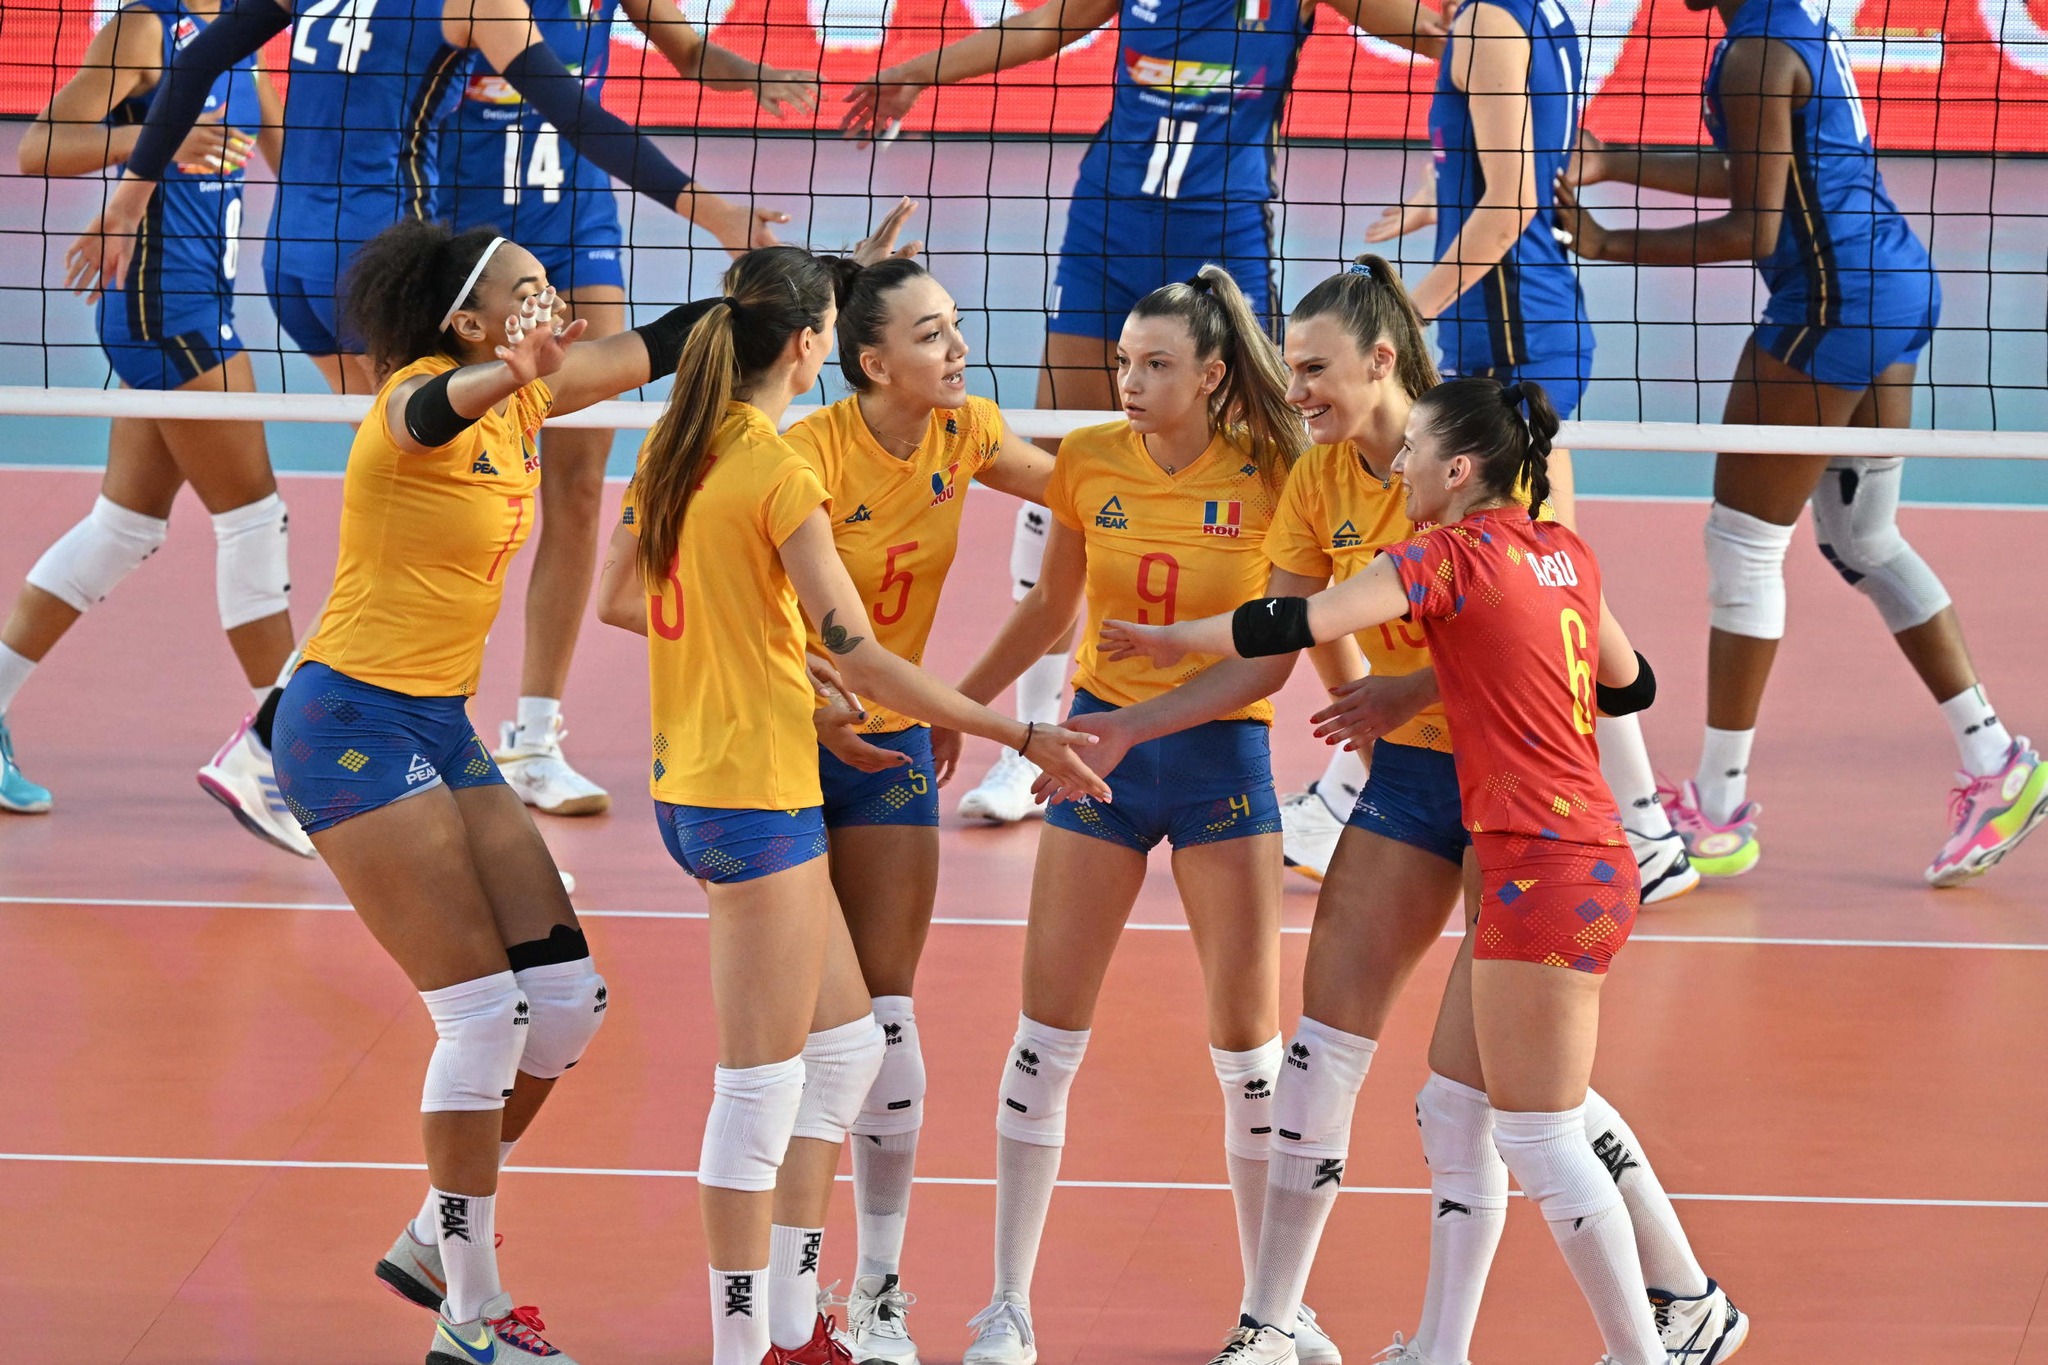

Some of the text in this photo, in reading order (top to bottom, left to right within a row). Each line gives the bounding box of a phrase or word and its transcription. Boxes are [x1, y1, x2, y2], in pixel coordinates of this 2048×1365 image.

[292, 0, 378, 74] 24
[503, 122, 565, 206] 14
[1141, 116, 1199, 199] 11
[472, 462, 500, 476] PEA
[524, 455, 541, 474] RO
[486, 497, 524, 582] 7
[1095, 515, 1130, 530] PEAK
[1202, 524, 1241, 539] ROU
[872, 540, 919, 626] 5
[1136, 551, 1180, 627] 9
[1559, 607, 1594, 735] 6
[908, 768, 928, 795] 5
[1015, 1059, 1039, 1077] errea
[1244, 1089, 1271, 1100] errea
[438, 1194, 472, 1243] PEAK
[797, 1232, 822, 1277] PEAK
[725, 1274, 754, 1318] PEAK
